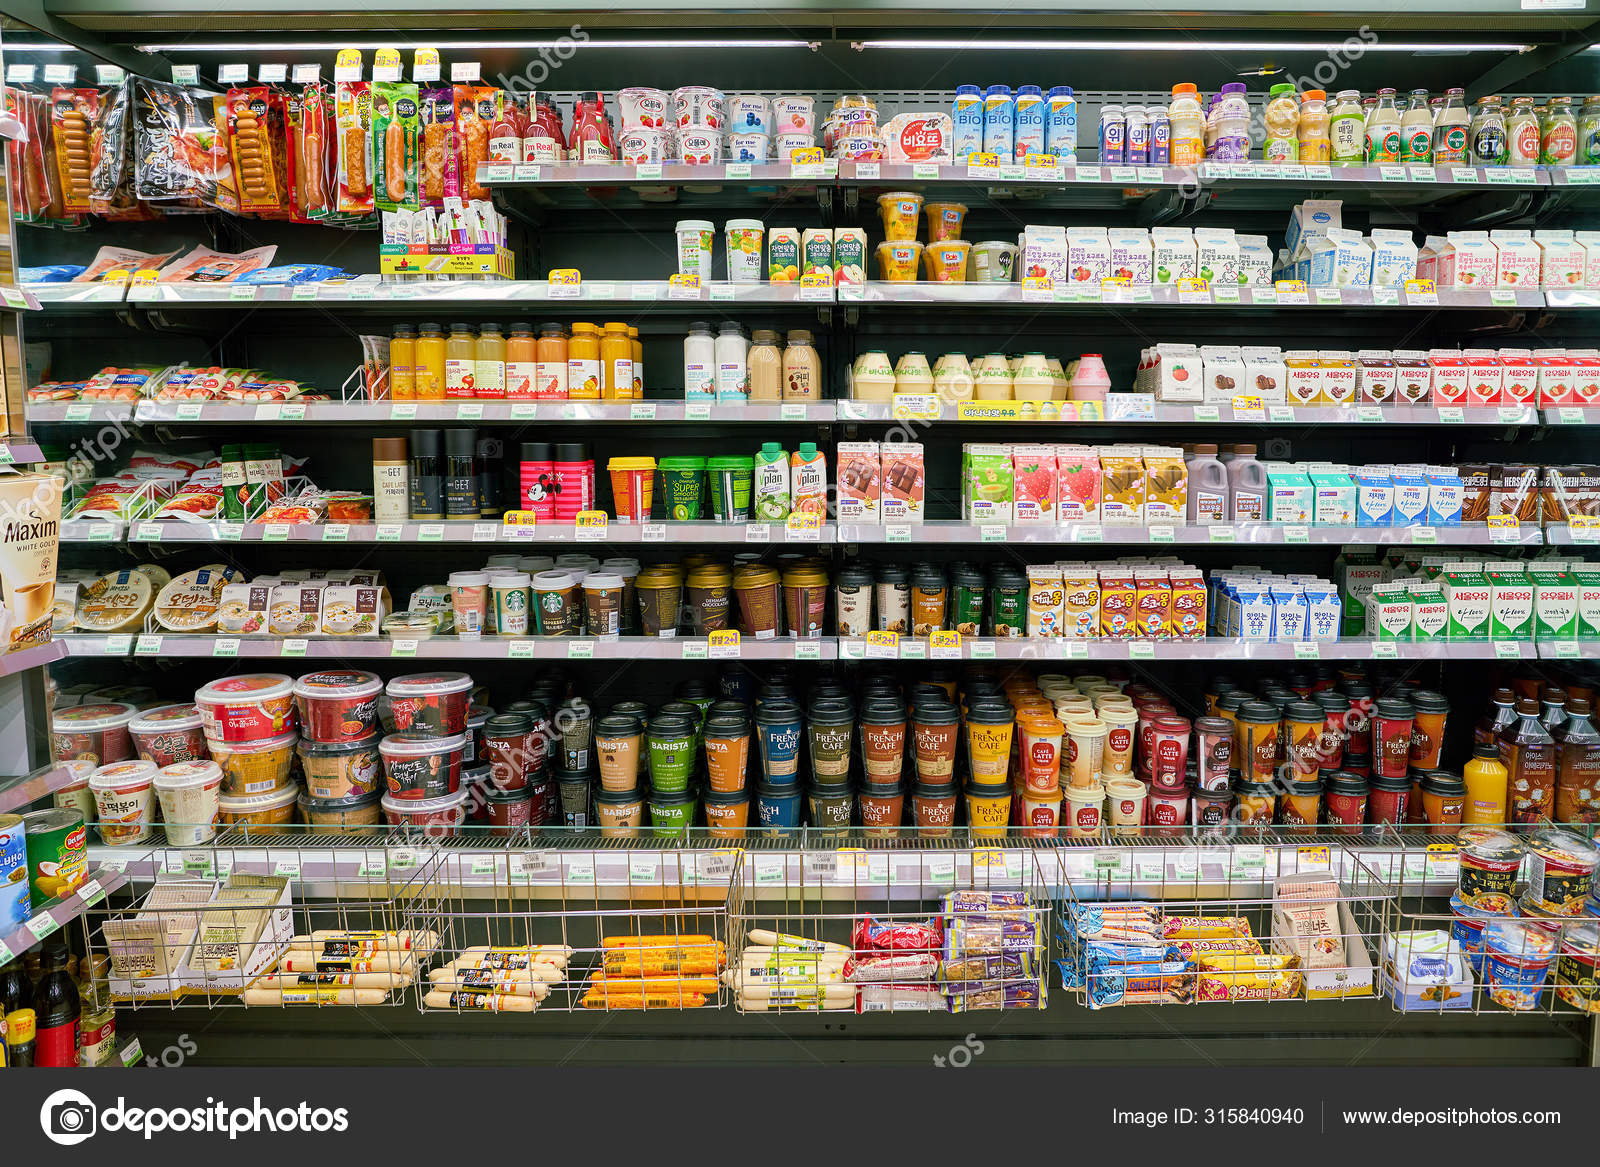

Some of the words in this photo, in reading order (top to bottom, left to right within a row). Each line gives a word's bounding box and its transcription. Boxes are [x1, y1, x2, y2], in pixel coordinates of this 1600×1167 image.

[959, 116, 981, 124] BIO
[989, 116, 1010, 124] BIO
[1020, 116, 1042, 125] BIO
[1053, 117, 1075, 126] BIO
[1339, 125, 1354, 134] 매일
[1338, 136, 1353, 144] 두유
[1478, 140, 1496, 152] GT
[808, 151, 821, 163] 2+1
[984, 156, 998, 167] 2+1
[1041, 156, 1055, 167] 2+1
[565, 272, 578, 284] 2+1
[685, 277, 699, 288] 2+1
[816, 276, 830, 286] 2+1
[1421, 282, 1435, 293] 2+1
[1292, 371, 1319, 379] 서울우유
[1367, 370, 1393, 378] 서울우유
[1401, 370, 1428, 378] 서울우유
[1438, 369, 1465, 377] 서울우유
[1473, 369, 1499, 377] 서울우유
[1248, 398, 1262, 409] 2+1
[964, 409, 999, 418] 바나나맛
[759, 473, 782, 486] Vplan
[797, 473, 820, 486] Vplan
[455, 479, 469, 490] GET
[673, 483, 699, 492] SUPER
[592, 514, 605, 526] 2+1
[1503, 516, 1516, 526] 2+1
[4, 520, 56, 543] Maxim
[17, 543, 37, 552] WHITE
[40, 540, 55, 548] GOLD
[1454, 592, 1488, 601] 서울우유
[1497, 592, 1531, 601] 서울우유
[1383, 606, 1409, 614] 서울우유
[1419, 606, 1446, 614] 서울우유
[1246, 612, 1267, 621] 맛있는
[1280, 613, 1301, 621] 맛있는
[1314, 612, 1335, 621] 맛있는
[1284, 621, 1298, 629] 우유
[34, 629, 50, 644] 100
[724, 633, 737, 644] 2+1
[882, 634, 896, 645] 2+1
[945, 634, 958, 645] 2+1
[816, 731, 850, 742] FRENCH
[869, 732, 902, 742] FRENCH
[973, 732, 1007, 742] FRENCH
[652, 742, 688, 750] BARISTA
[778, 742, 796, 750] CAFE
[919, 742, 939, 750] CAFE
[1525, 752, 1543, 760] 아이스
[603, 807, 640, 815] BARISTA
[929, 815, 949, 823] CAFE
[989, 853, 1004, 865] 2+1
[1313, 849, 1328, 862] 2+1
[1182, 918, 1200, 926] 99
[1193, 942, 1211, 950] 99
[1229, 986, 1246, 998] 99
[1315, 984, 1350, 993] Everyday
